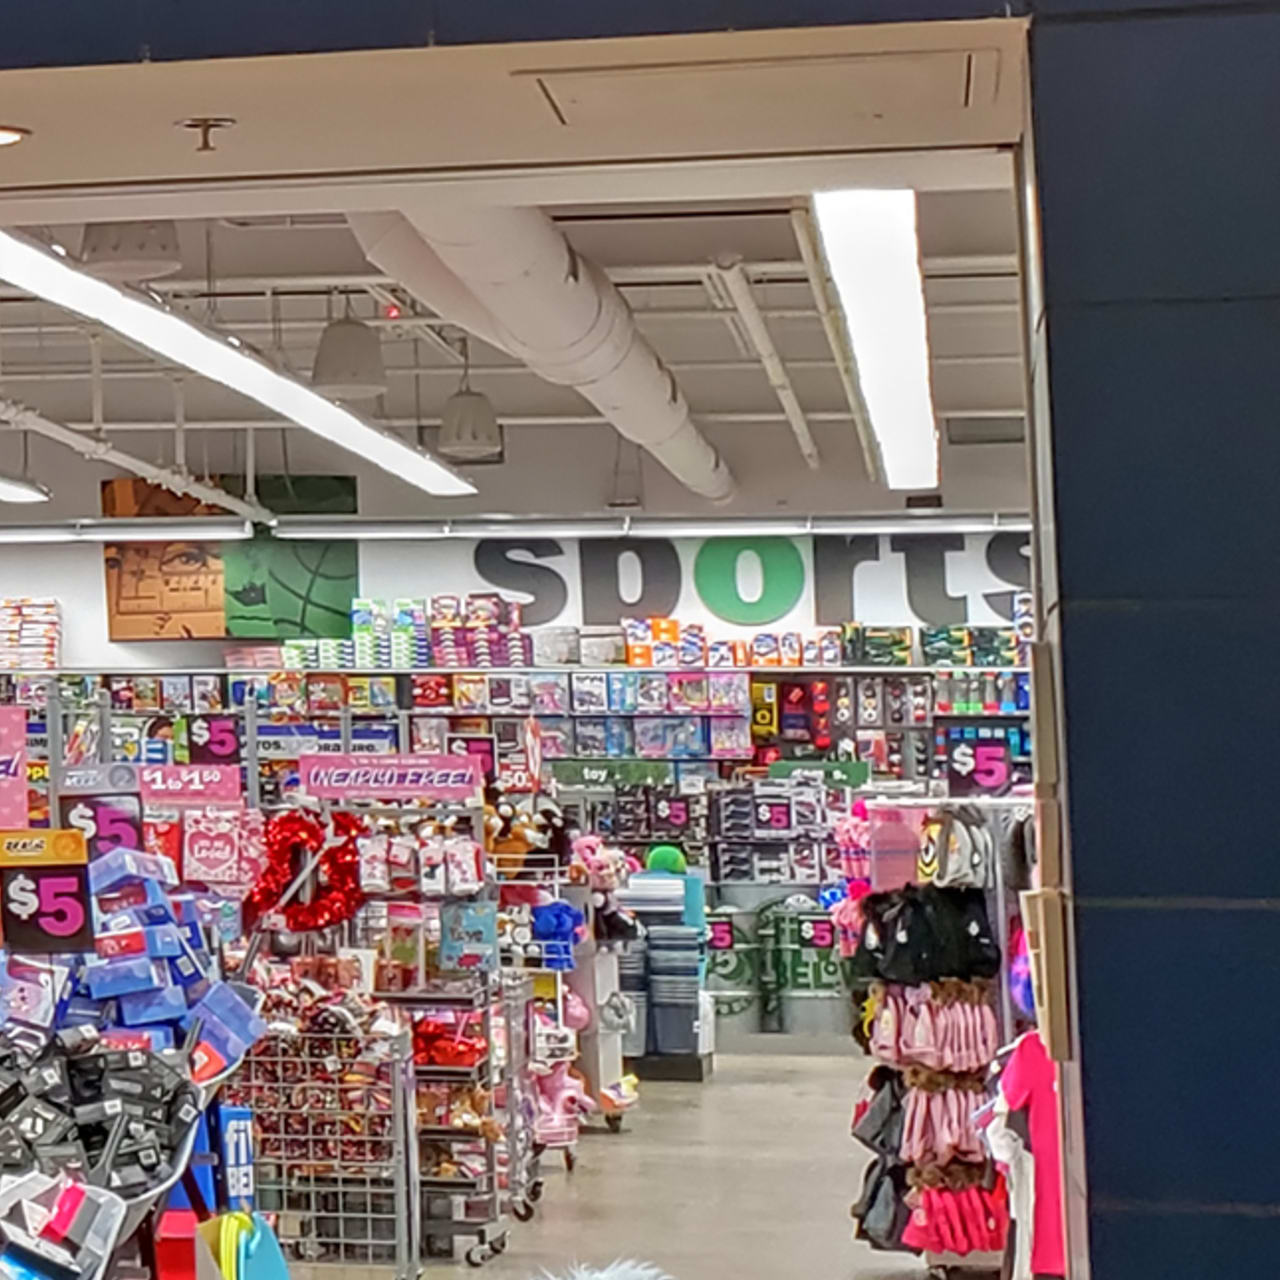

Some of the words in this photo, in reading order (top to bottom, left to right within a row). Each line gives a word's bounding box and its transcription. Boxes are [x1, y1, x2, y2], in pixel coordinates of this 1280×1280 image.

[191, 717, 239, 757] $5
[951, 742, 1008, 788] $5
[68, 802, 139, 855] $5
[656, 799, 688, 825] $5
[757, 804, 789, 828] $5
[7, 873, 84, 938] $5
[800, 921, 833, 948] $5
